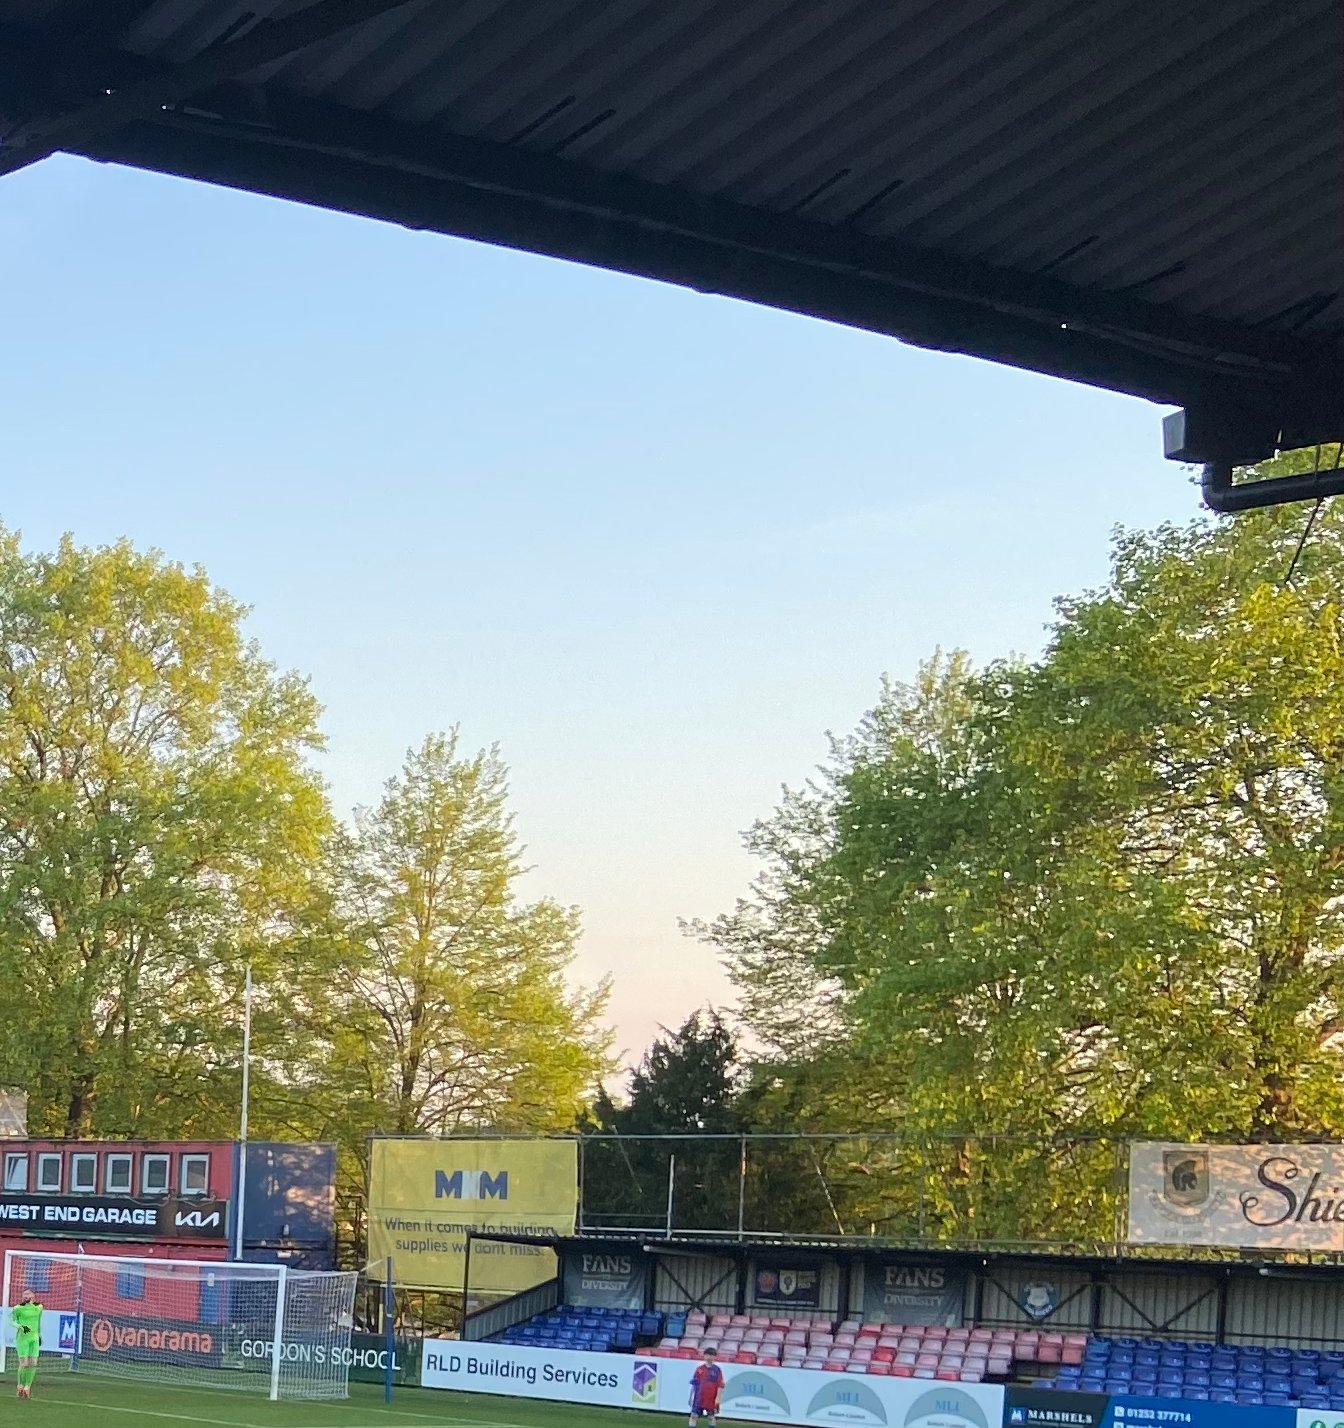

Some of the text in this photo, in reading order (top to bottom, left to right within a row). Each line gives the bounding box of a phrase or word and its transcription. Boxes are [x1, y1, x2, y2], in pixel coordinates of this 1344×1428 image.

[44, 1205, 80, 1222] END
[82, 1207, 157, 1225] GARAGE
[385, 1217, 420, 1231] When
[425, 1218, 432, 1231] it
[437, 1221, 477, 1234] comes
[482, 1221, 495, 1233] to
[396, 1238, 447, 1254] supplies
[582, 1253, 632, 1274] FANS
[581, 1280, 629, 1291] DIVERSITY
[884, 1266, 946, 1288] FANS
[884, 1294, 942, 1307] DIVERSITY
[113, 1327, 212, 1354] vanarama
[331, 1347, 401, 1370] SCHOOL
[426, 1353, 618, 1388] RLD Building Services
[1028, 1410, 1092, 1424] MARSHELS
[1127, 1408, 1155, 1420] 01252
